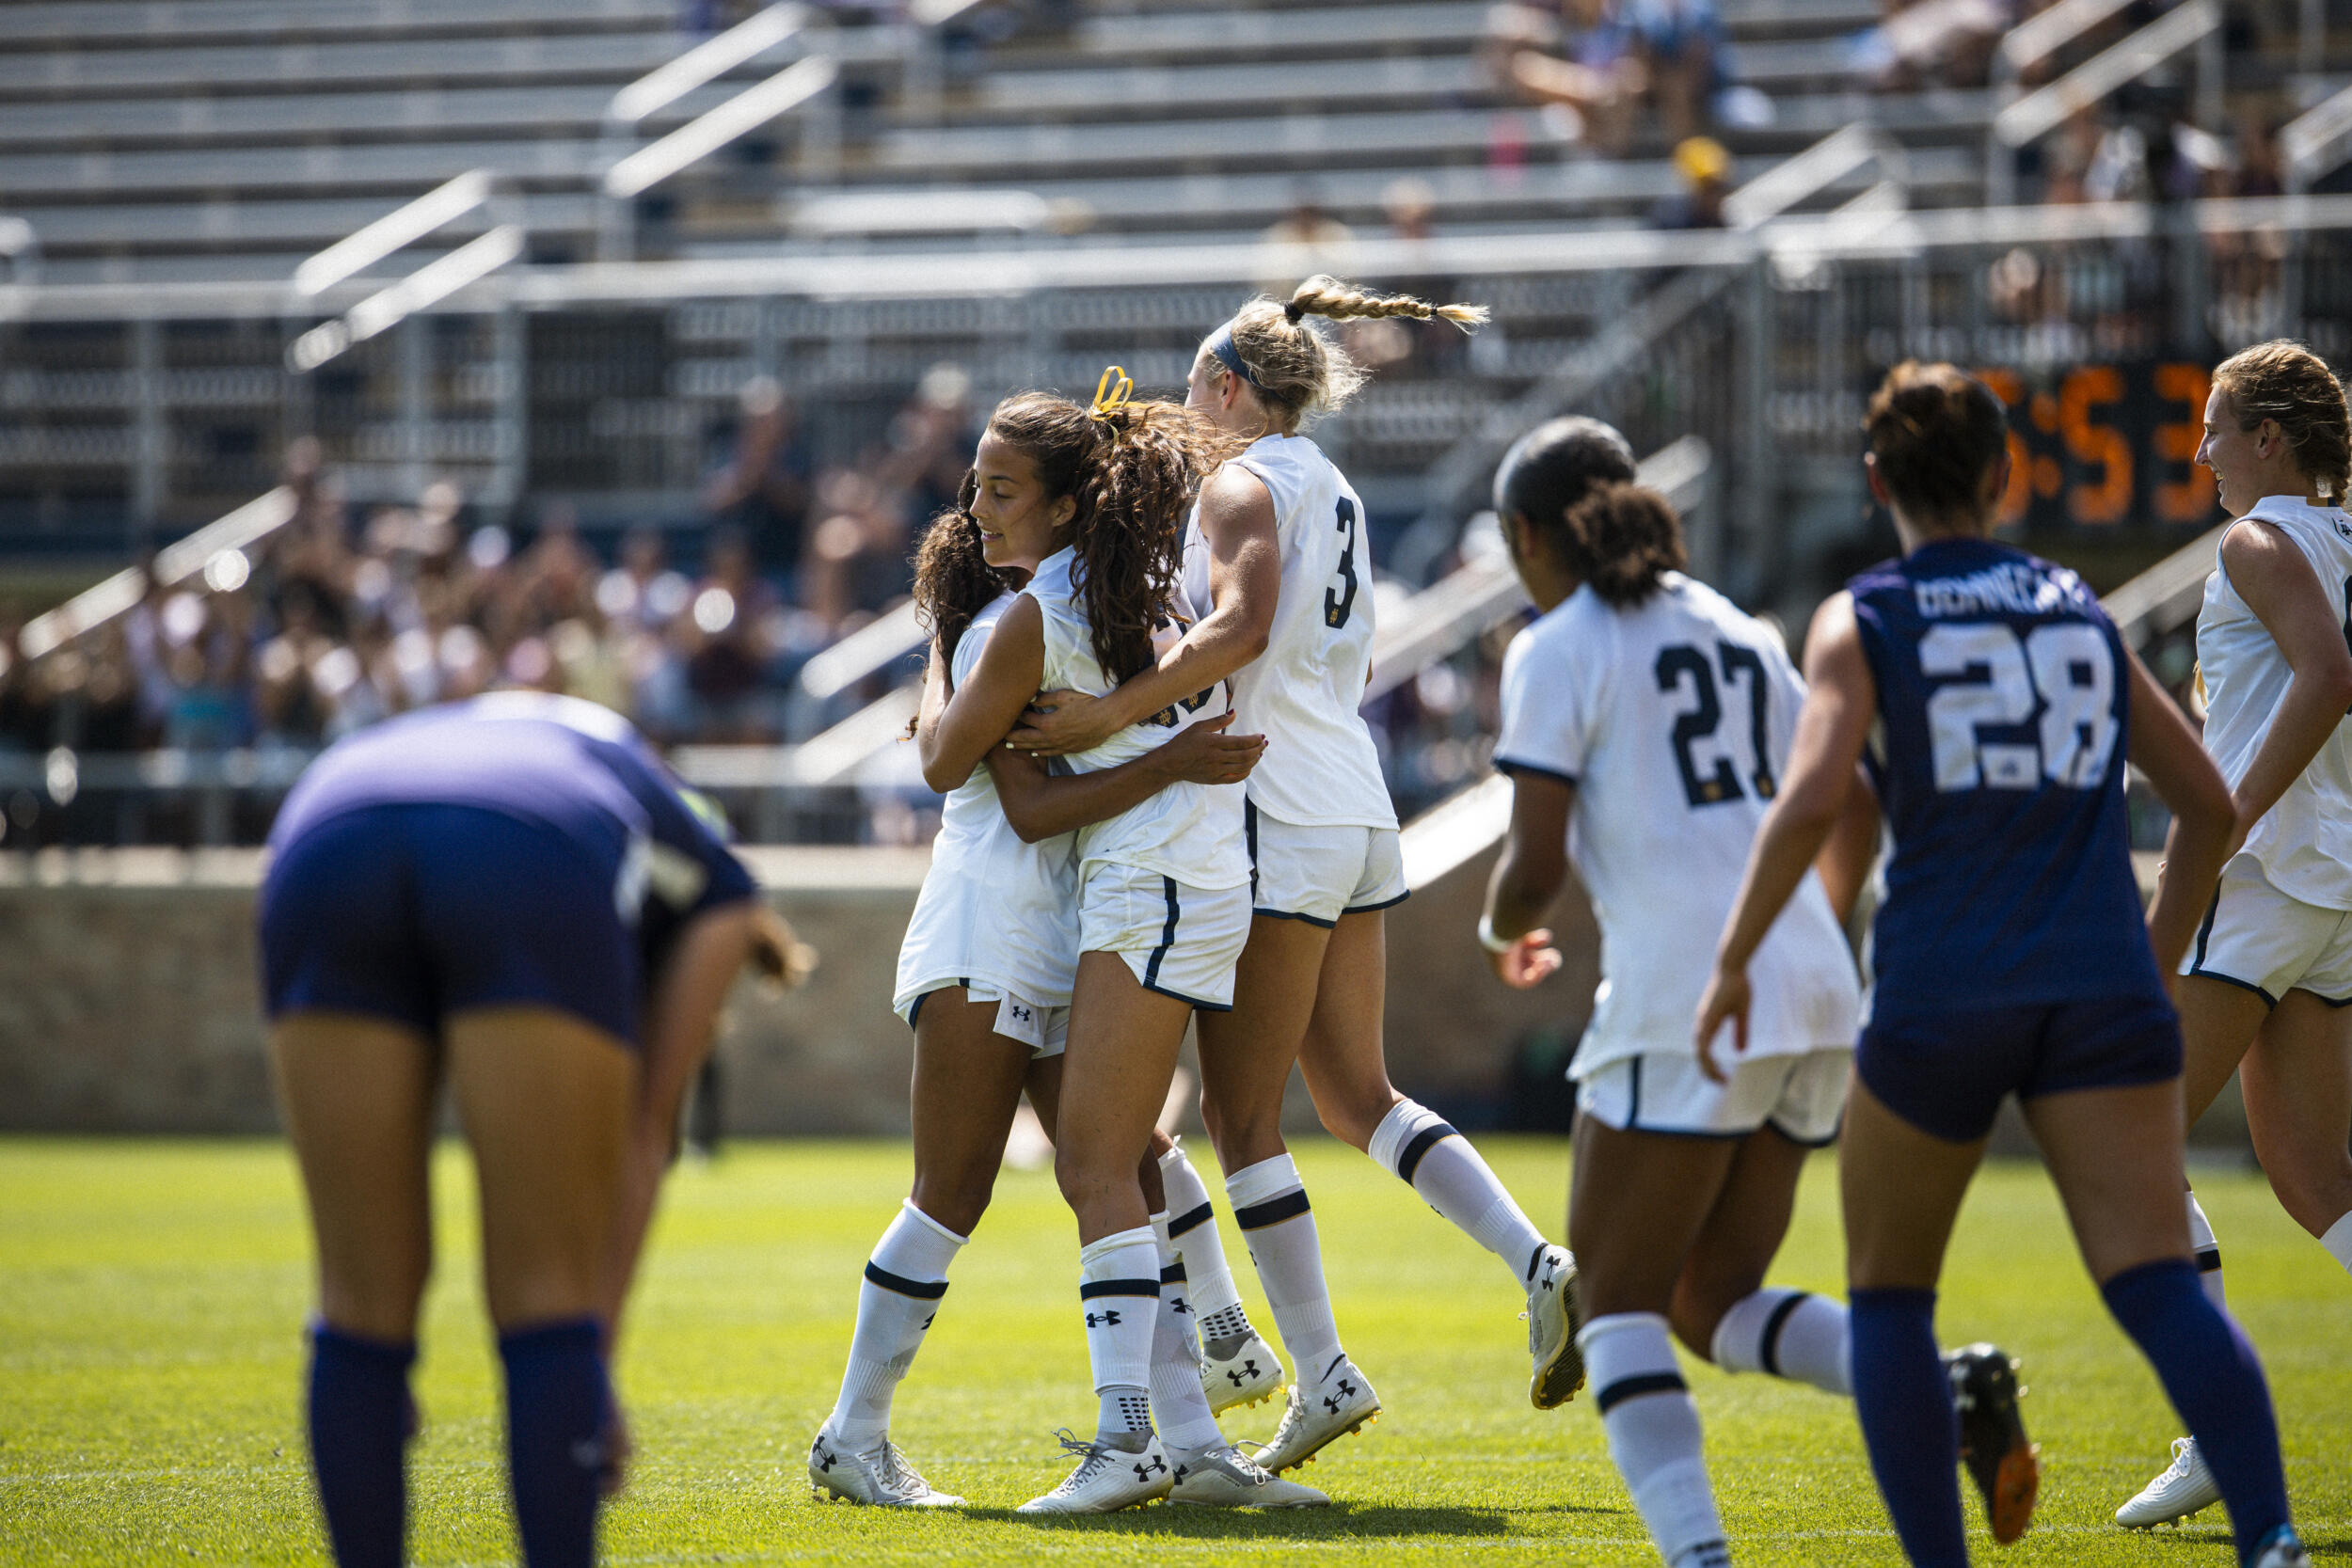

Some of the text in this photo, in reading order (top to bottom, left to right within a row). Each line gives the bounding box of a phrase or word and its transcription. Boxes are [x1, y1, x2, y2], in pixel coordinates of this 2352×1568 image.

[1324, 496, 1358, 629] 3
[1654, 641, 1776, 809] 27
[1917, 623, 2120, 793] 28
